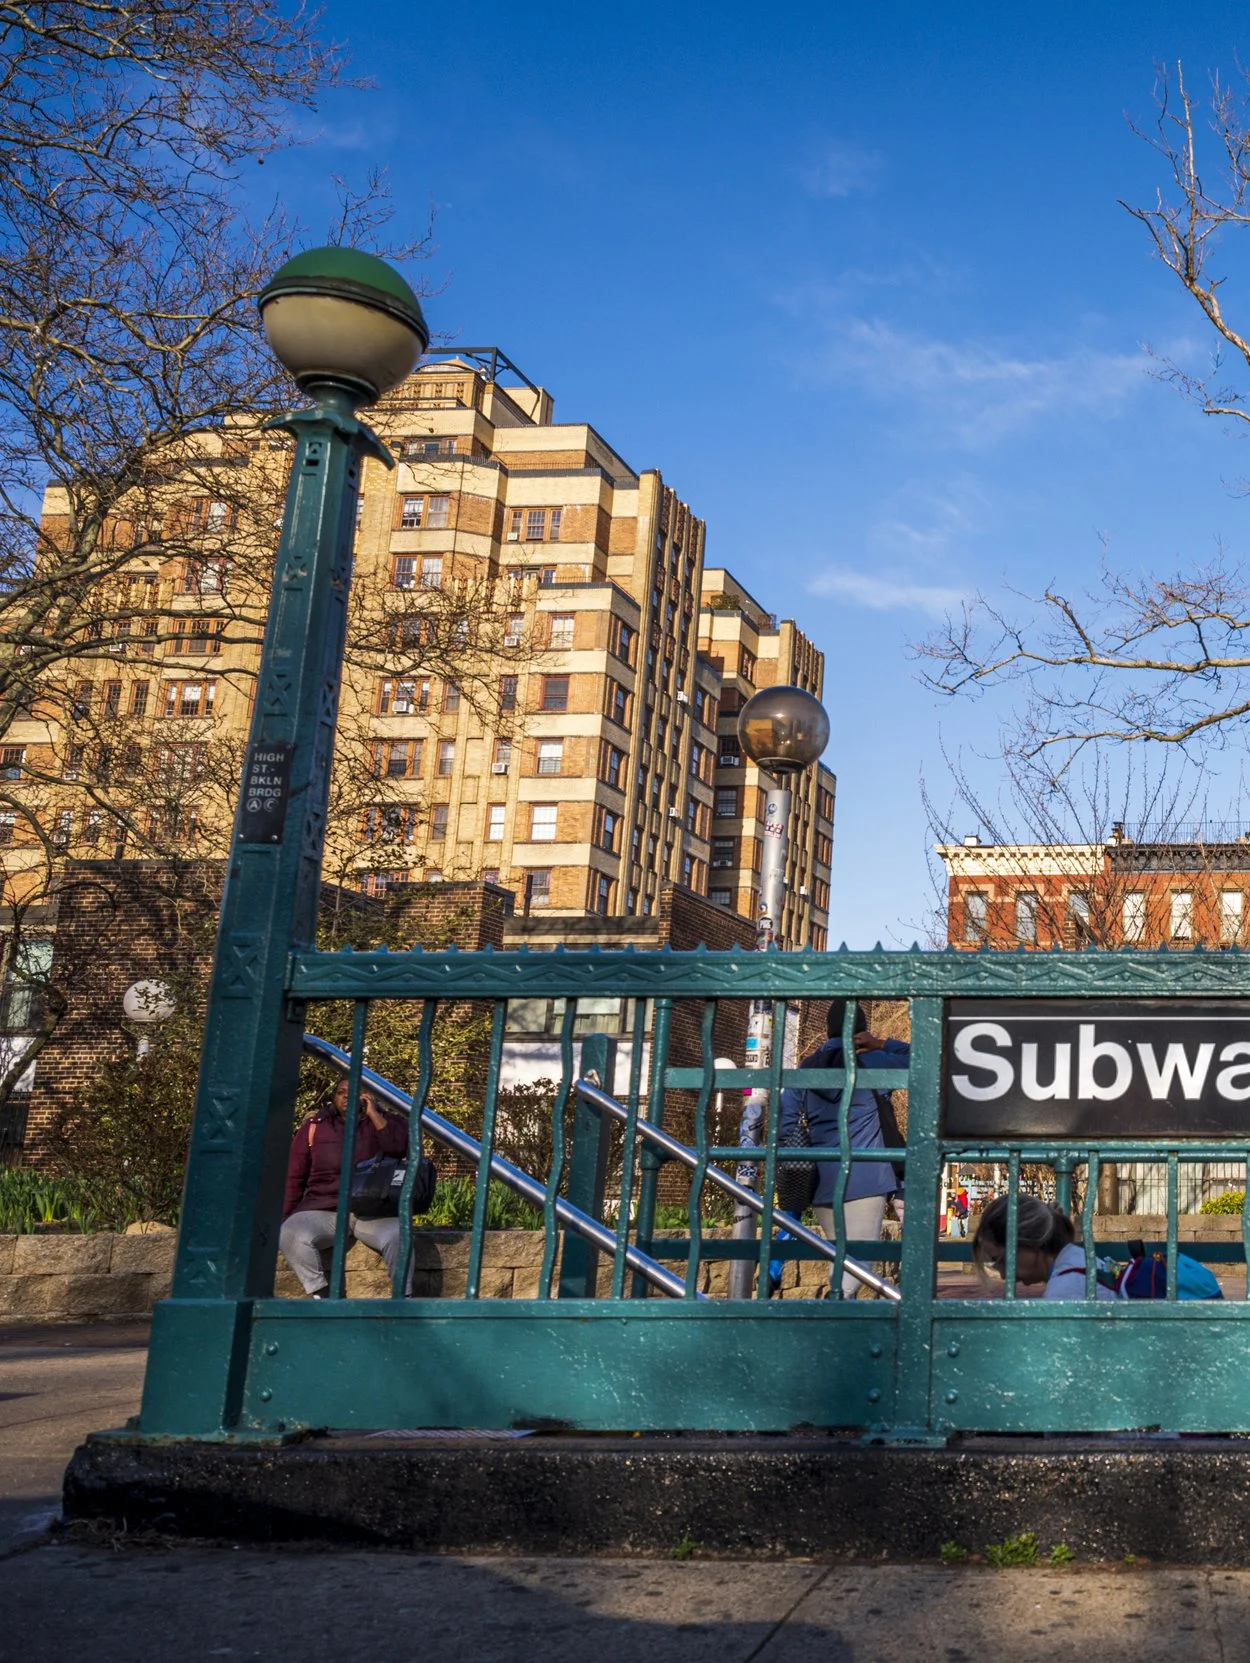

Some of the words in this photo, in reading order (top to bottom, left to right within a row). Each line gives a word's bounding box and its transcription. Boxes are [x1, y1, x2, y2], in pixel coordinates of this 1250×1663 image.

[253, 752, 285, 762] HIGH
[250, 775, 282, 786] BKLN
[248, 787, 282, 798] BRDG
